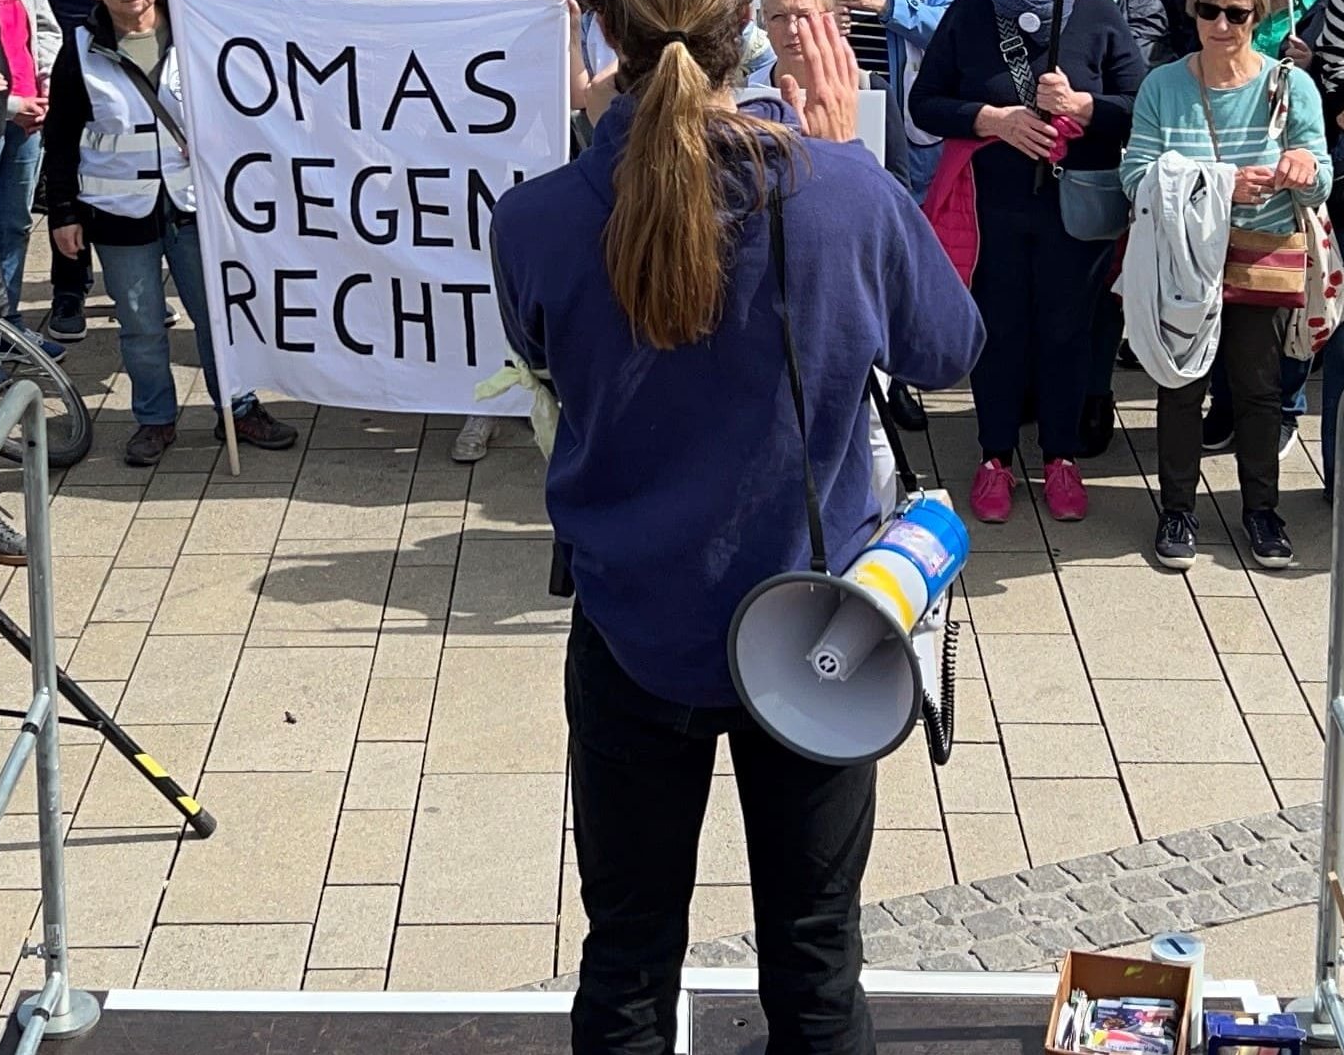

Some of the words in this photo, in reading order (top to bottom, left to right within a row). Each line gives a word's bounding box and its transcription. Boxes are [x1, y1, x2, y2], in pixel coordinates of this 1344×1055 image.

[217, 36, 517, 134] OMAS
[224, 151, 525, 252] GEGEN
[219, 260, 493, 367] RECHT
